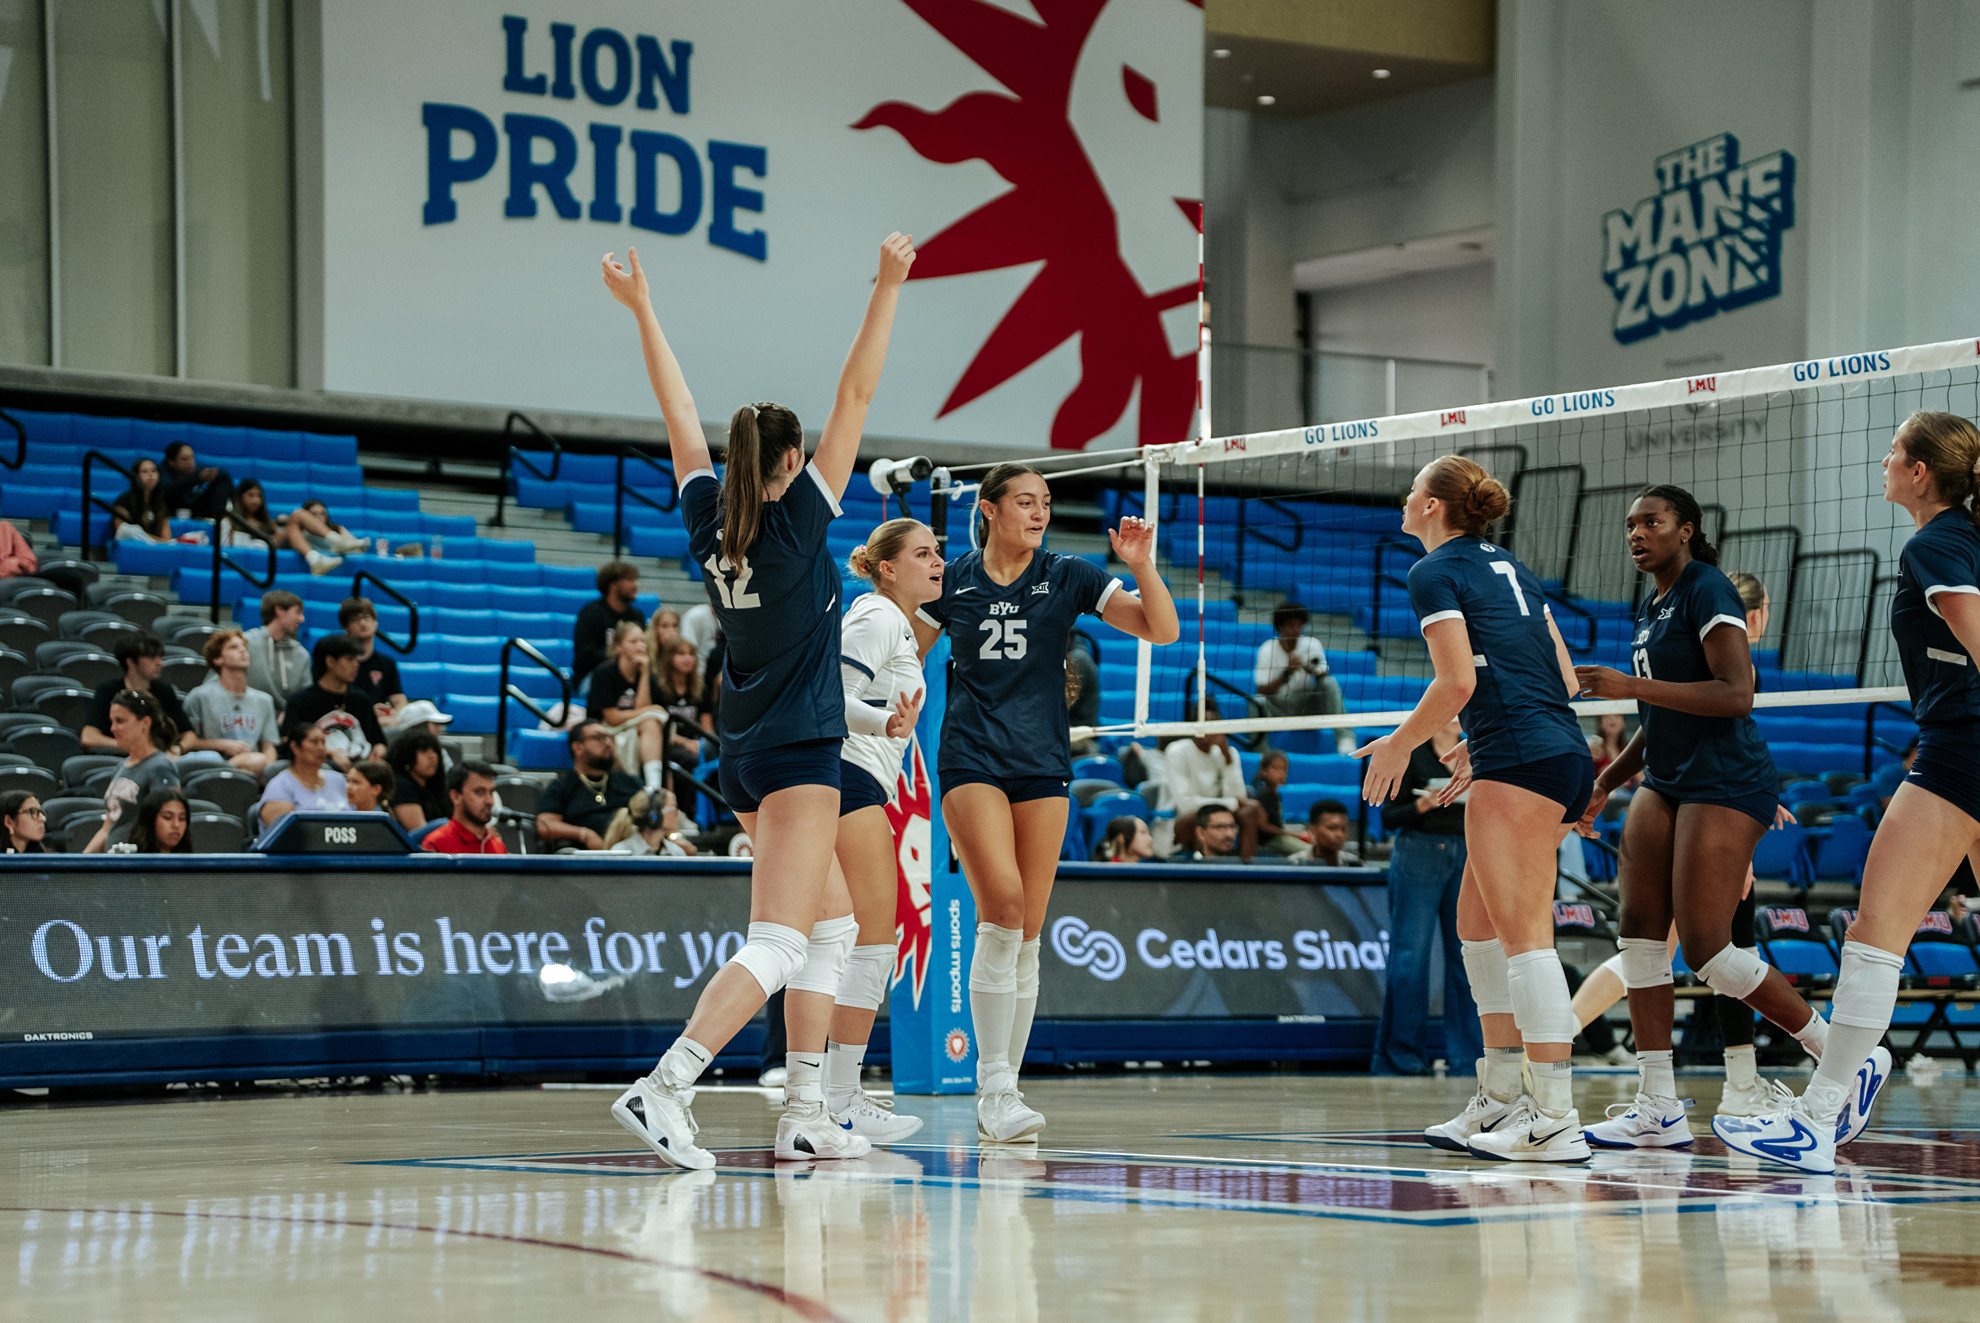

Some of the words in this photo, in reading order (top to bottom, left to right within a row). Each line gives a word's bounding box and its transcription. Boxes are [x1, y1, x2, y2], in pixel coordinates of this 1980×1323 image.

[502, 14, 693, 115] LION
[1657, 134, 1729, 192] THE
[422, 102, 768, 262] PRIDE
[1793, 361, 1820, 382] GO
[1828, 351, 1891, 377] LIONS
[1687, 376, 1716, 395] LMU
[1532, 397, 1555, 416] GO
[1563, 389, 1616, 412] LIONS
[1305, 427, 1325, 445] GO
[1332, 420, 1379, 442] LIONS
[1440, 410, 1466, 427] LMU
[1224, 437, 1247, 453] LMU
[704, 553, 761, 609] 12
[1488, 561, 1530, 616] 7
[989, 601, 1020, 616] BYU
[979, 619, 1028, 660] 25
[1632, 647, 1653, 680] 13
[220, 714, 257, 735] LMU
[324, 827, 357, 844] POSS
[948, 899, 962, 949] sports
[1553, 901, 1596, 928] LMU
[1766, 907, 1811, 933] LMU
[1917, 910, 1953, 935] MU
[31, 919, 172, 982] Our
[187, 923, 358, 980] team
[371, 917, 425, 976] is
[435, 917, 573, 976] here
[584, 916, 666, 975] for
[673, 930, 746, 989] yo
[1136, 927, 1288, 970] Cedars
[1292, 929, 1390, 970] Sinai
[949, 950, 963, 1013] imports
[24, 1031, 94, 1042] DAKTRONICS
